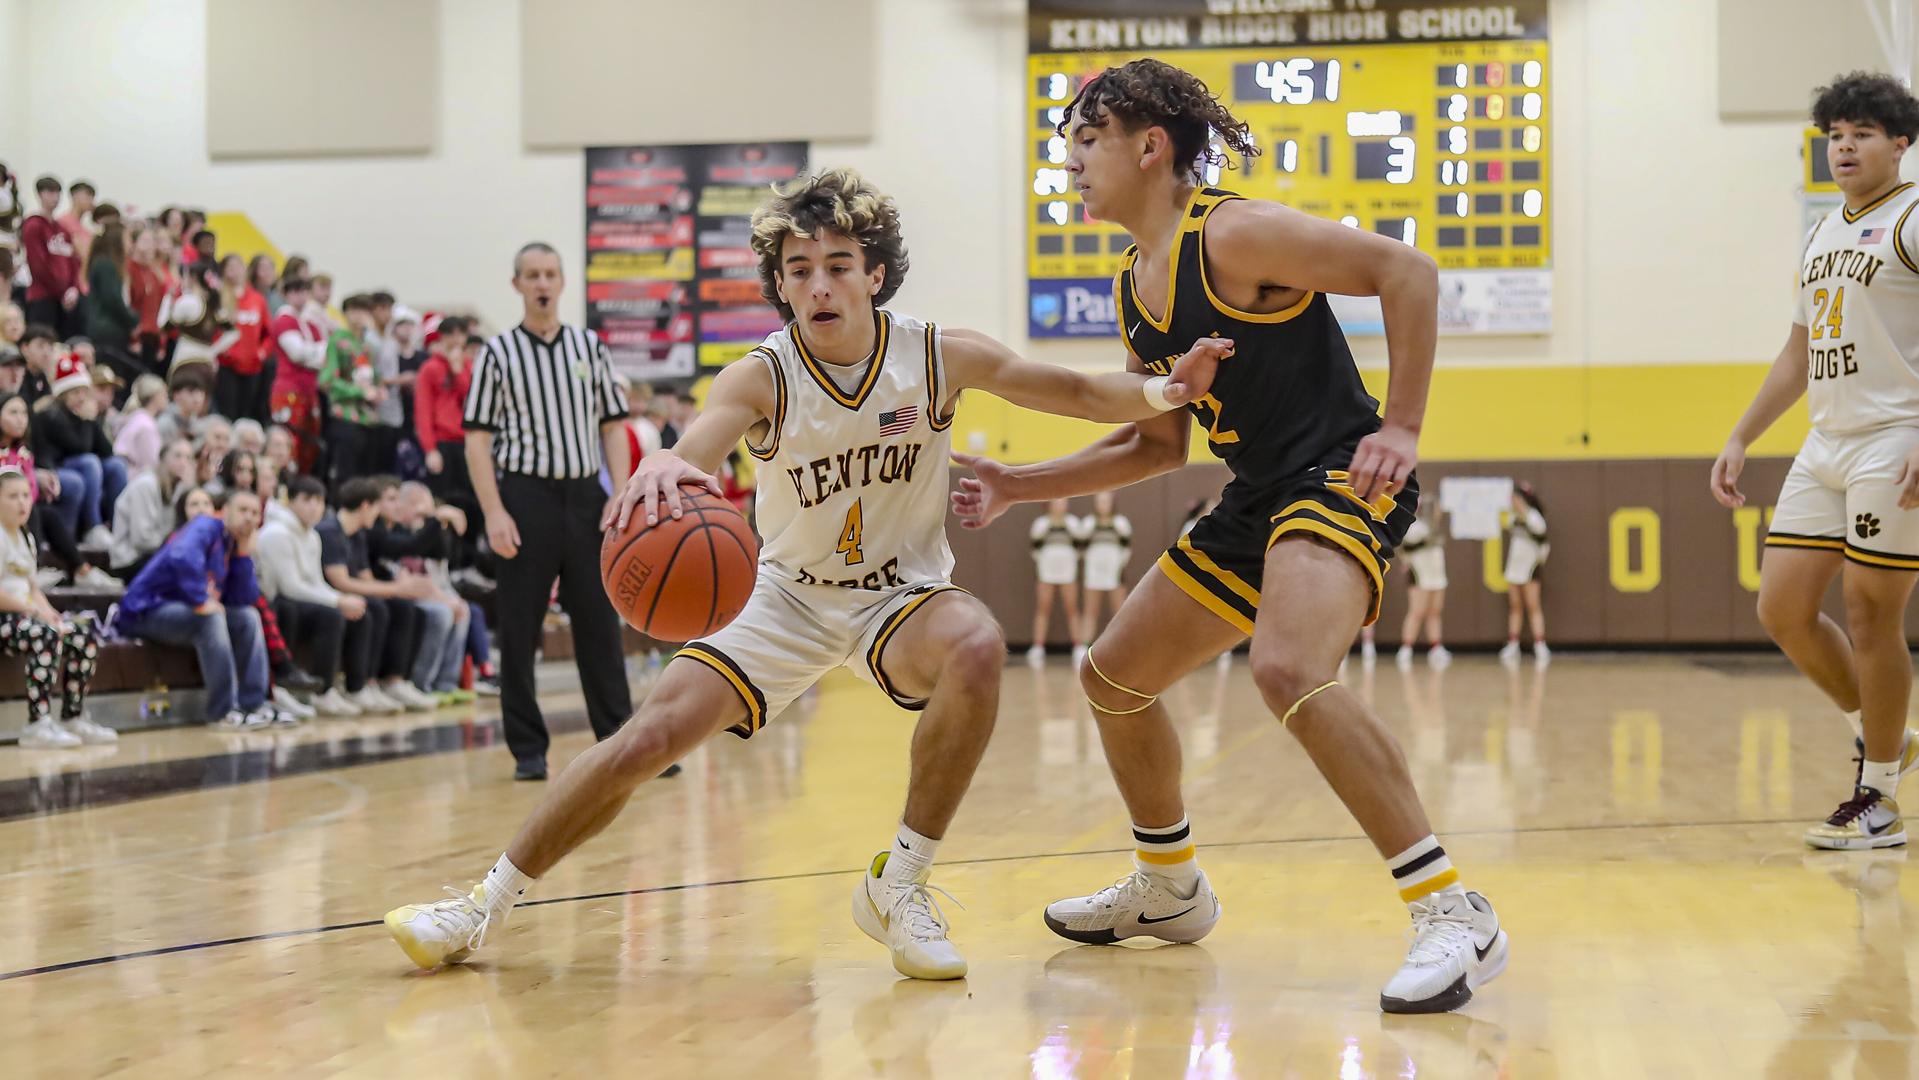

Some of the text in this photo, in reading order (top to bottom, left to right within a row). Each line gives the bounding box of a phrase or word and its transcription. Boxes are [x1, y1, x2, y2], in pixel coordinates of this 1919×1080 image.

[1051, 6, 1524, 48] KENTON RIDGE HIGH SCHOOL
[1385, 136, 1416, 185] 3
[1802, 249, 1884, 288] ENTON
[1811, 286, 1845, 340] 24
[1808, 343, 1858, 380] IDGE
[787, 444, 922, 508] KENTON
[836, 496, 865, 566] 4
